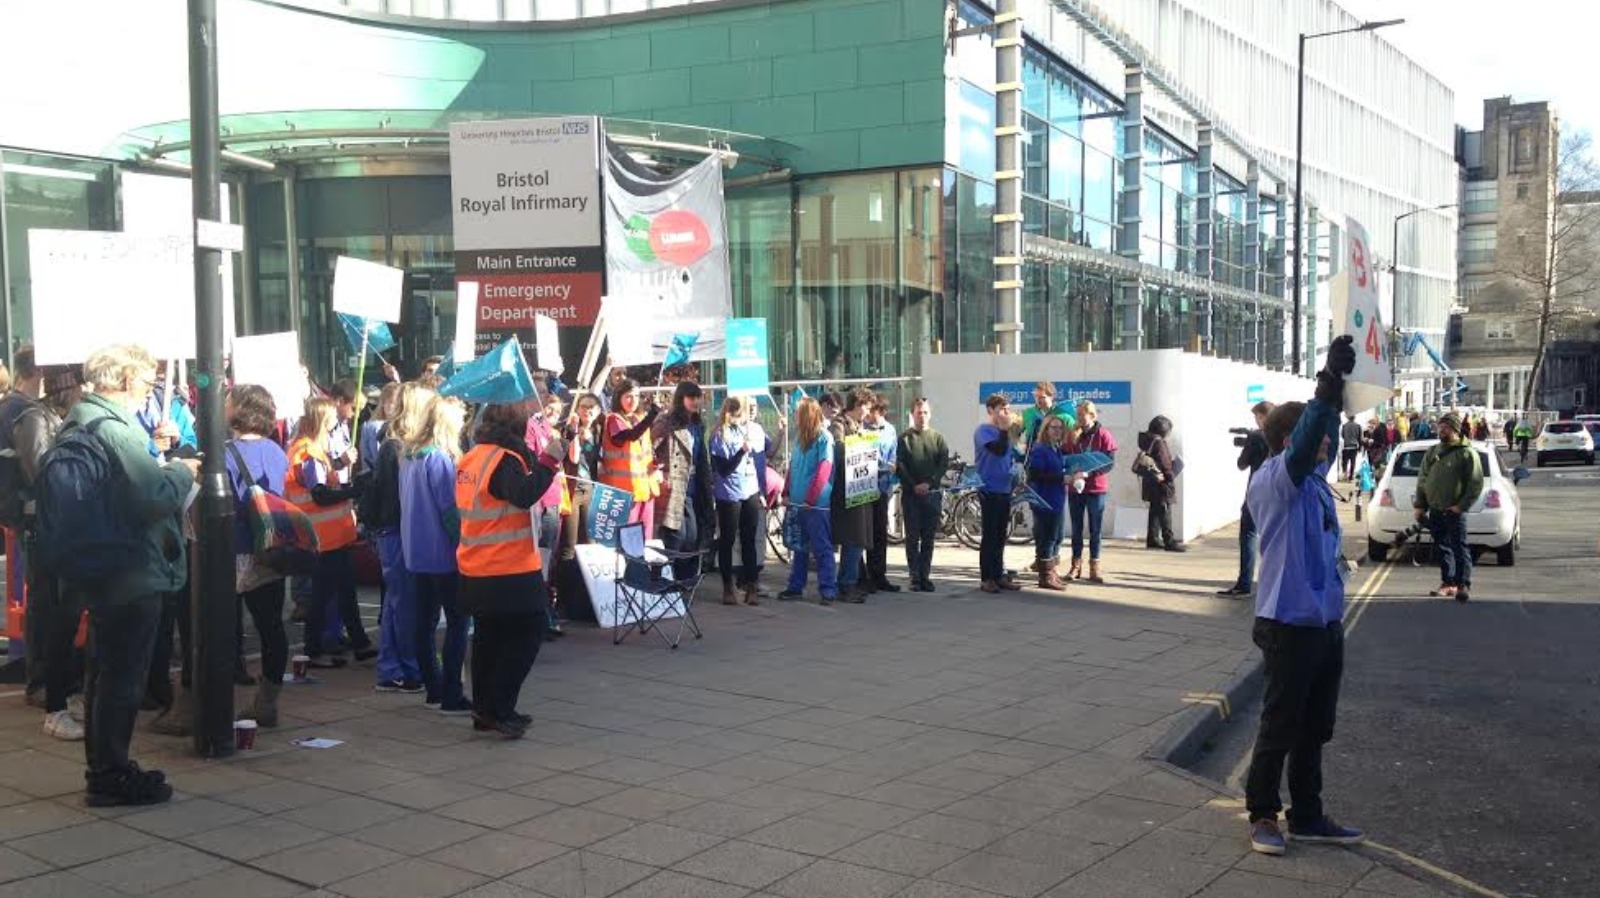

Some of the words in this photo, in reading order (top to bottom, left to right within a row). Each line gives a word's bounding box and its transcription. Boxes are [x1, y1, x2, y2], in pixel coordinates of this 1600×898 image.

[563, 123, 587, 134] NHS
[497, 170, 549, 187] Bristol
[460, 196, 506, 216] Royal
[511, 194, 588, 212] Infirmary
[476, 255, 511, 270] Main
[516, 255, 577, 268] Entrance
[484, 282, 571, 301] Emergency
[853, 464, 869, 479] NHS
[598, 489, 614, 510] the
[610, 499, 625, 517] We
[595, 512, 608, 539] BMA
[604, 519, 616, 540] are
